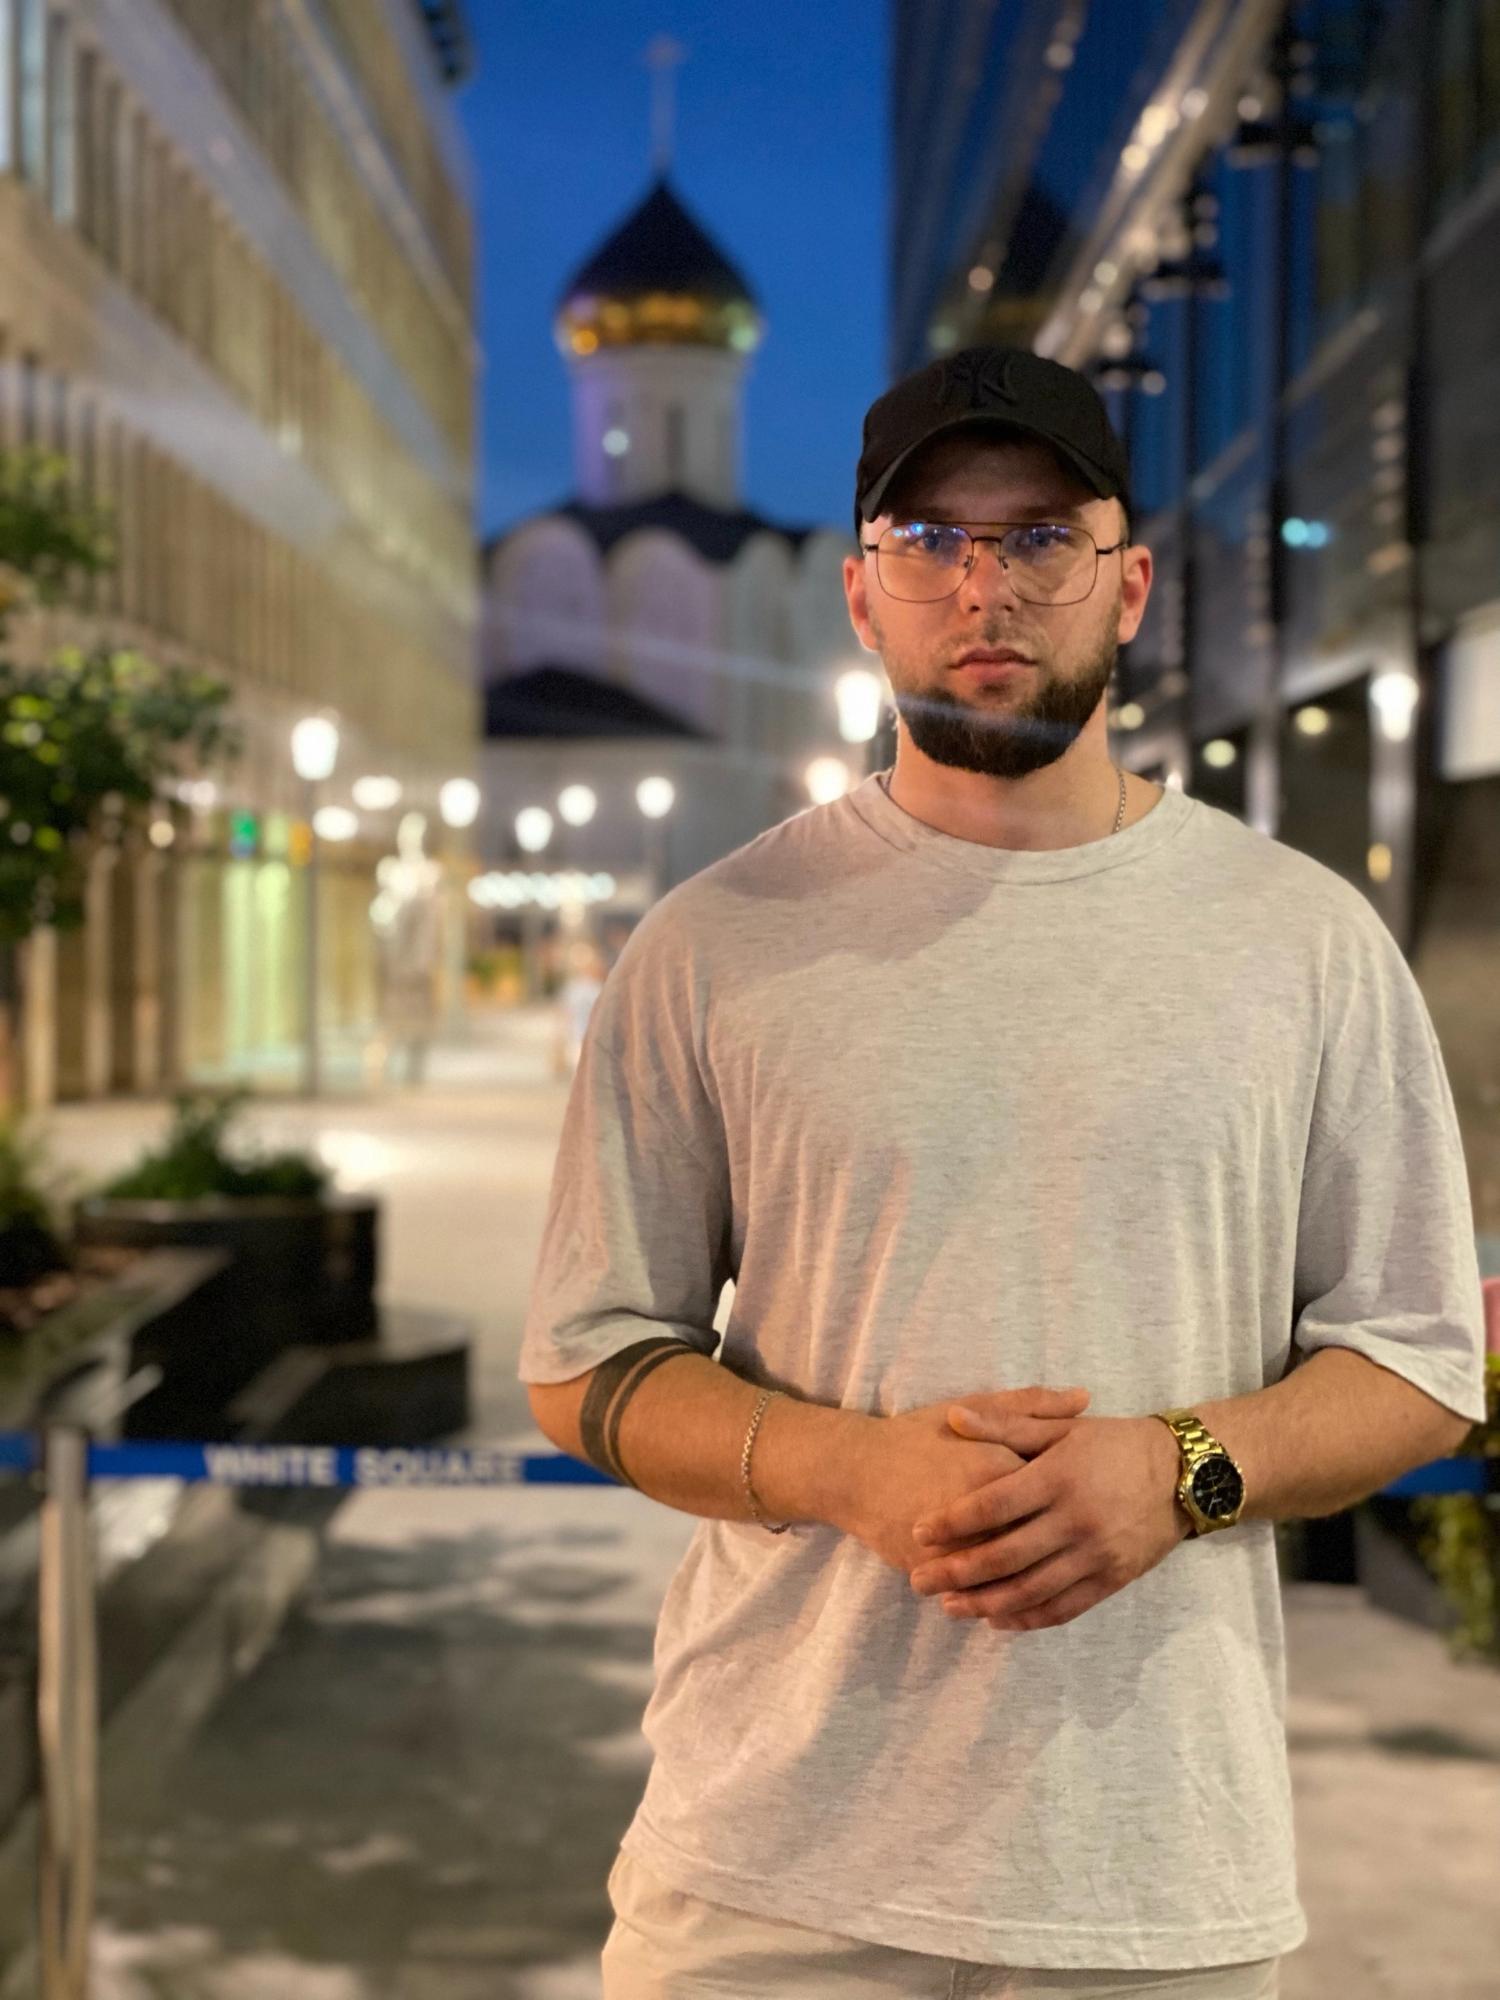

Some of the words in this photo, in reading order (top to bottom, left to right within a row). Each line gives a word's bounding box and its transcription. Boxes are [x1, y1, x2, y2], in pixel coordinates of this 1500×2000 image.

[940, 348, 1018, 408] NY
[204, 1446, 337, 1485] WHITE
[354, 1448, 523, 1486] SQUARE
